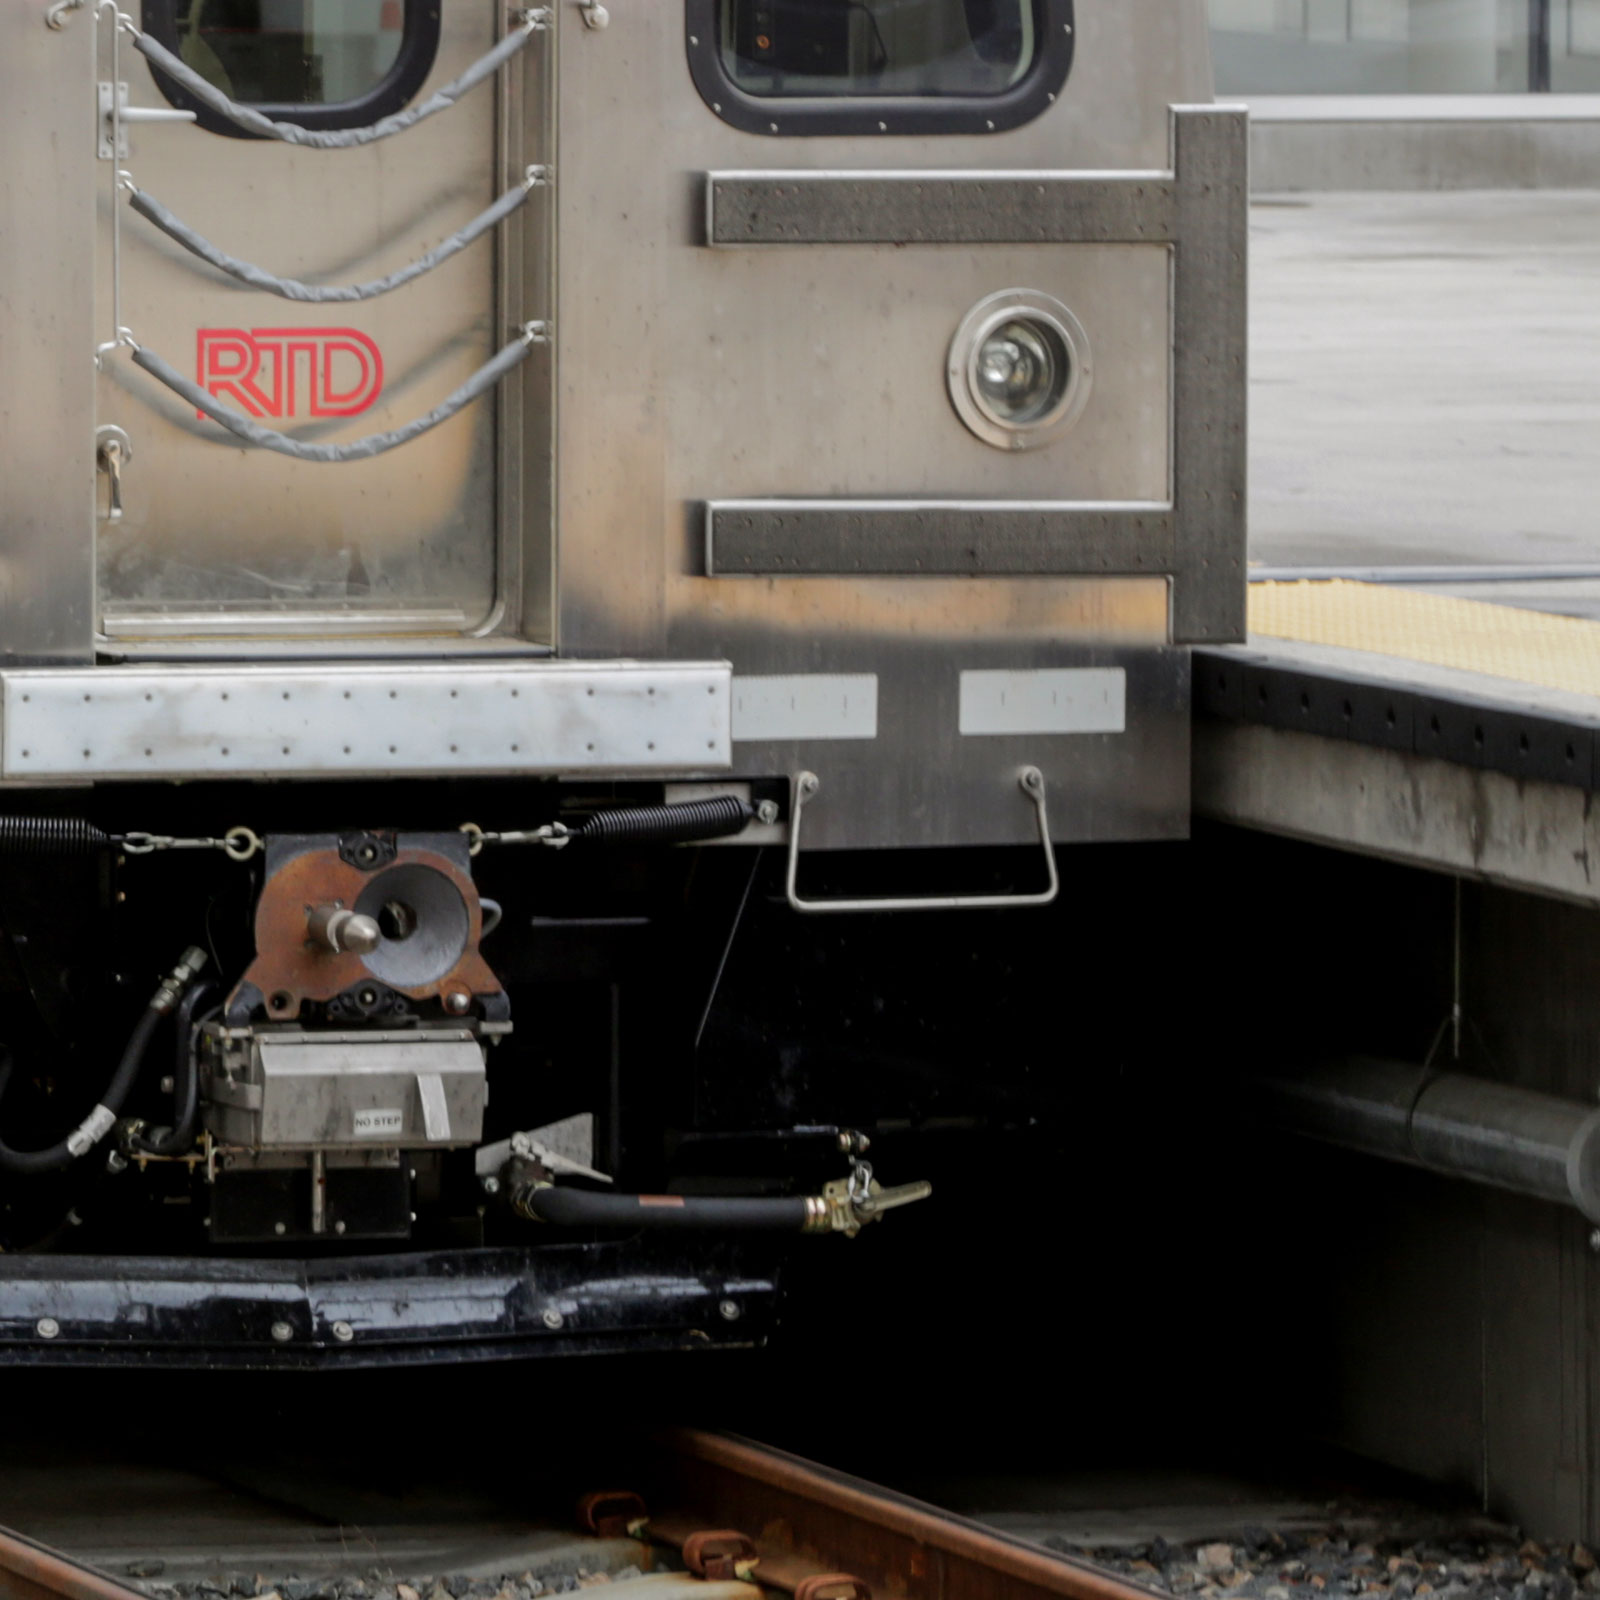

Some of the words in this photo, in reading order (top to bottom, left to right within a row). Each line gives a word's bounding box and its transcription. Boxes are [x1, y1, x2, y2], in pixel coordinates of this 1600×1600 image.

[196, 327, 384, 420] RTD
[355, 1117, 371, 1127] NO
[374, 1115, 401, 1126] STEP
